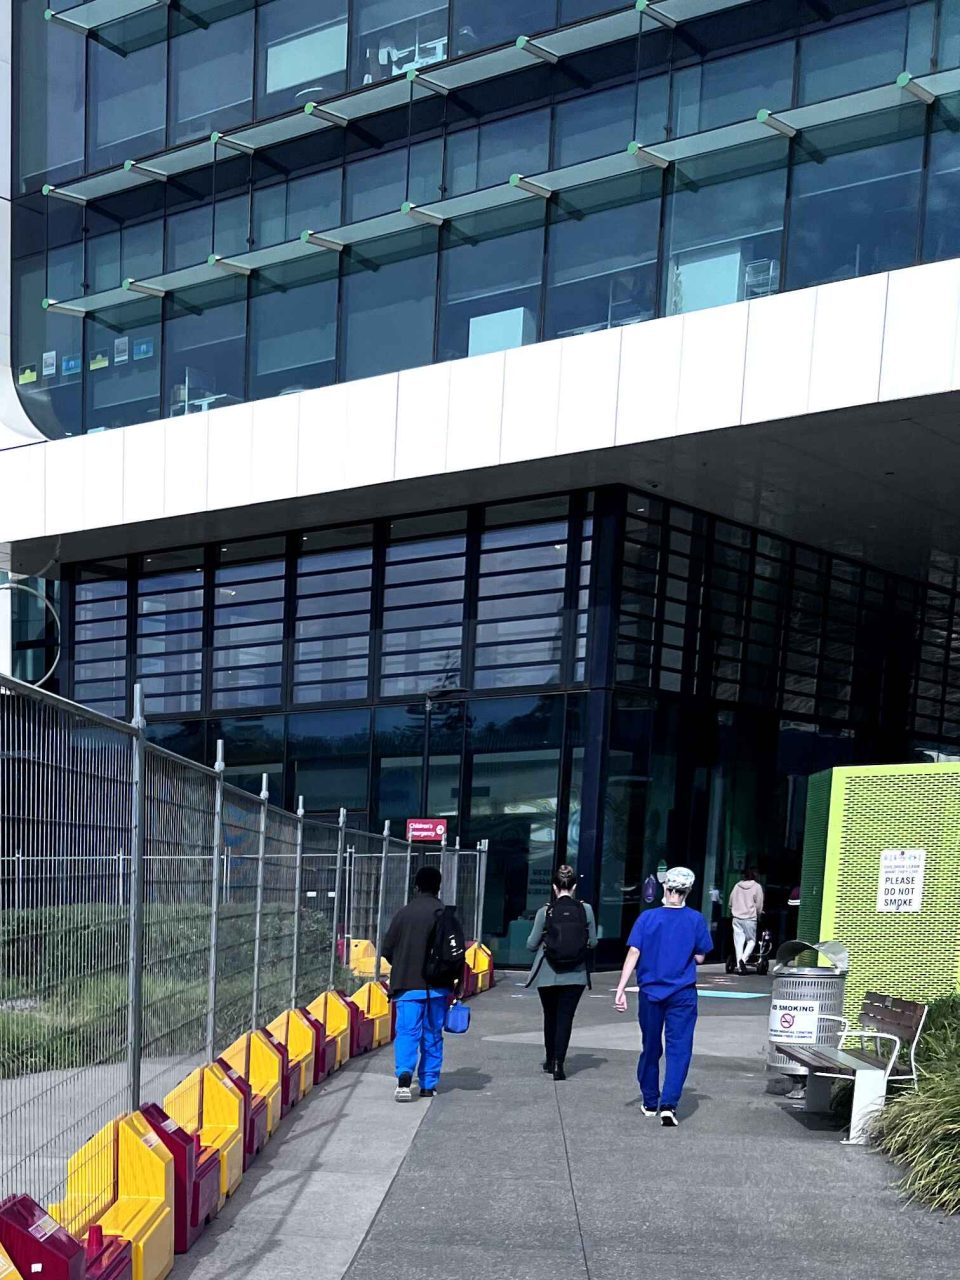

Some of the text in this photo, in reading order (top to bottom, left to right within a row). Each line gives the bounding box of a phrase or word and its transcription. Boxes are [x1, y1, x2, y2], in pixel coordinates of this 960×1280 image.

[884, 876, 916, 885] PLEASE
[884, 887, 916, 896] DO NOT
[883, 898, 913, 907] SMOKE
[778, 1004, 815, 1012] SMOKING
